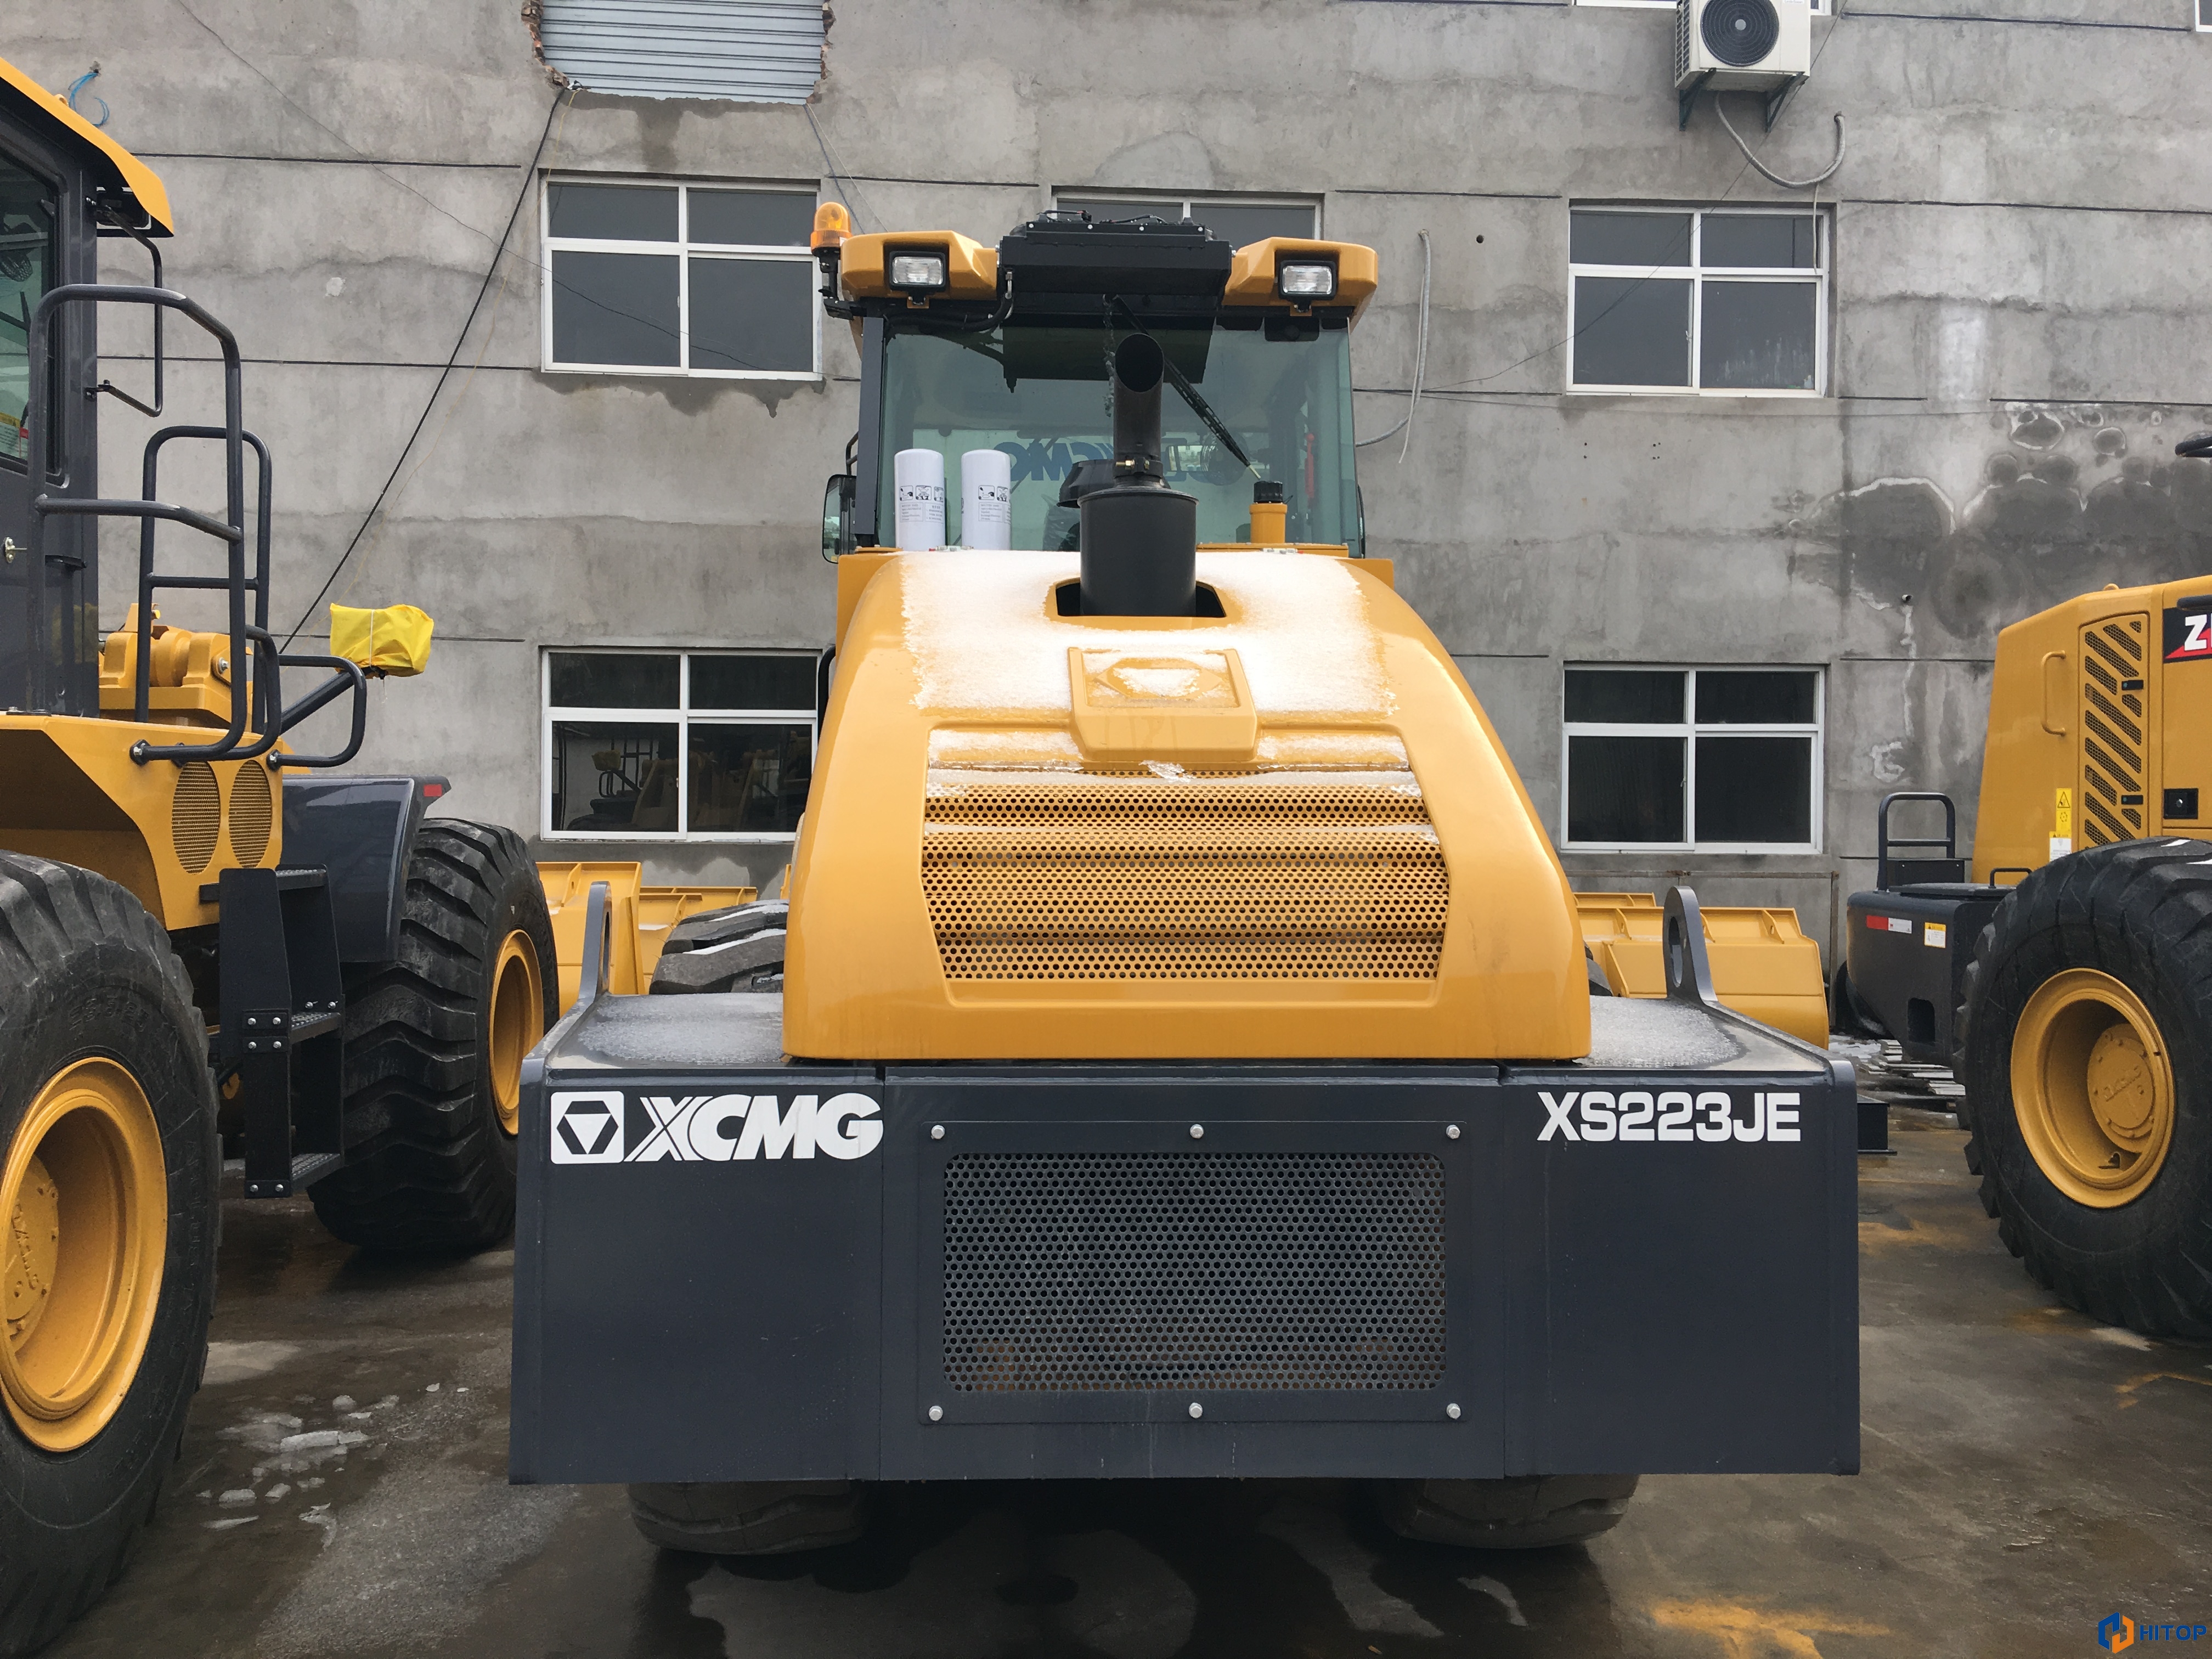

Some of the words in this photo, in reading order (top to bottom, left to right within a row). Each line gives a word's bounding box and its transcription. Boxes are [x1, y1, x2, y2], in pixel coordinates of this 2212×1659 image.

[2184, 613, 2212, 651] Z
[624, 1093, 884, 1162] XCMG
[1537, 1091, 1801, 1142] XS223JE
